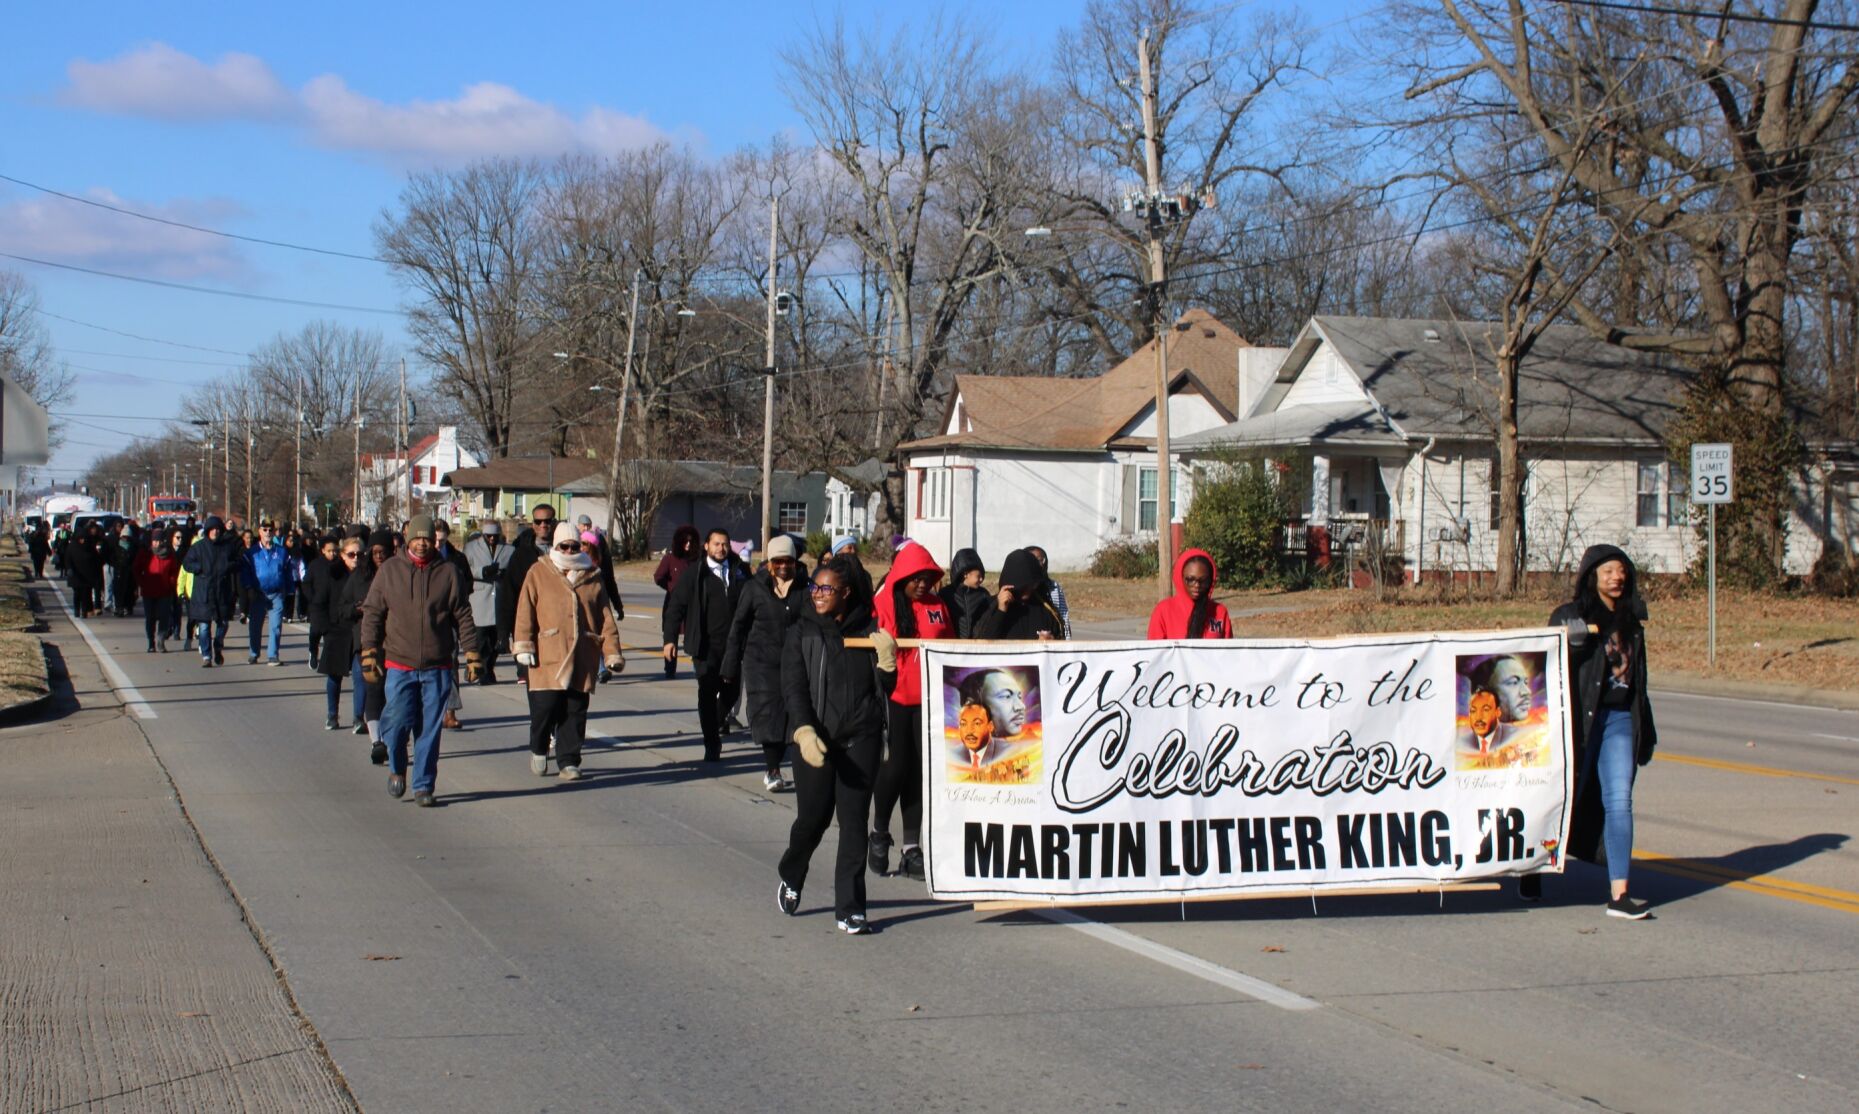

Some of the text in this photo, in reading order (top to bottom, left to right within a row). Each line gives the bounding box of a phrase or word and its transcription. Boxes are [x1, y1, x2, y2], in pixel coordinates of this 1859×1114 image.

[1695, 451, 1729, 460] SPEED
[1699, 463, 1725, 472] LIMIT
[1698, 475, 1728, 496] 35
[926, 609, 945, 624] M
[1057, 659, 1436, 713] Welcome to the
[1052, 701, 1446, 813] Celebration
[962, 787, 986, 802] Have
[964, 807, 1534, 879] MARTIN LUTHER KING, JR.
